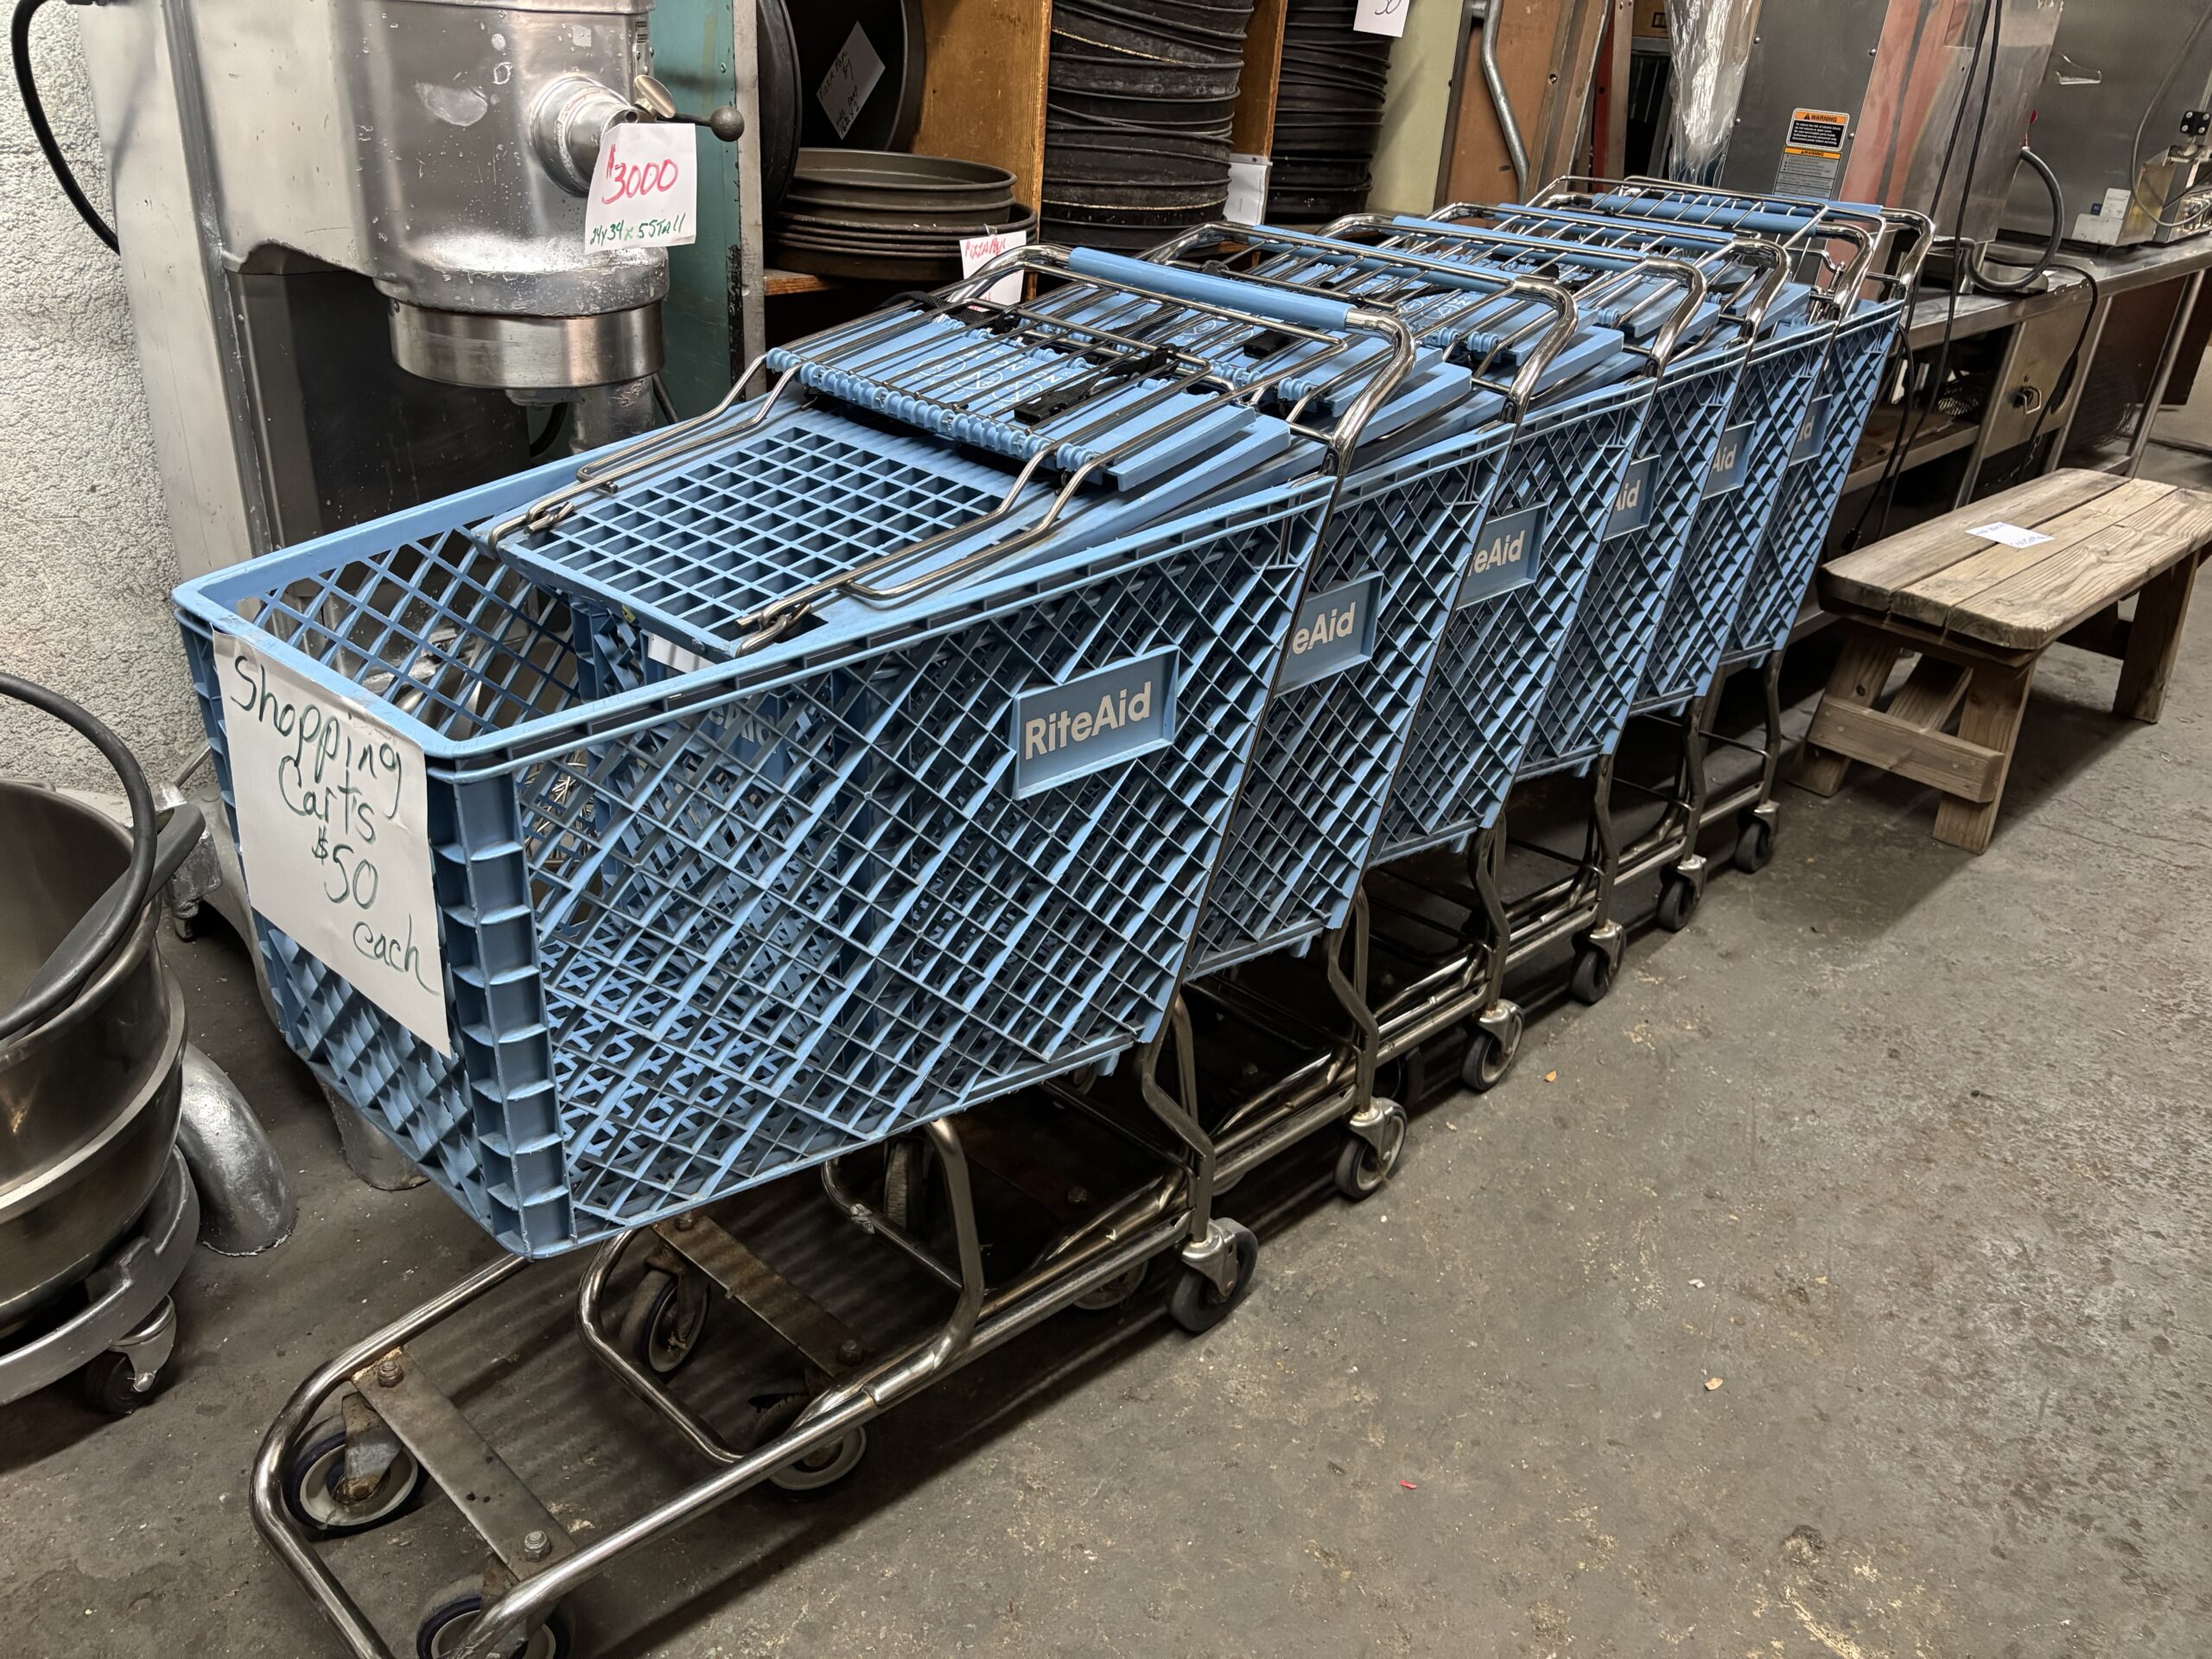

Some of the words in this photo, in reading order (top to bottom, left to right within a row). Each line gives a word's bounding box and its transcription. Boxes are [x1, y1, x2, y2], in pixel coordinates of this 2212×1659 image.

[1811, 113, 1838, 123] WARNING
[601, 143, 679, 205] $3000
[1468, 529, 1526, 577] eAid
[1286, 601, 1357, 659] eAid
[230, 654, 403, 821] Shopping
[1025, 680, 1152, 760] RiteAid
[278, 753, 378, 845] Carts
[311, 824, 379, 910] $50
[353, 913, 442, 996] each
